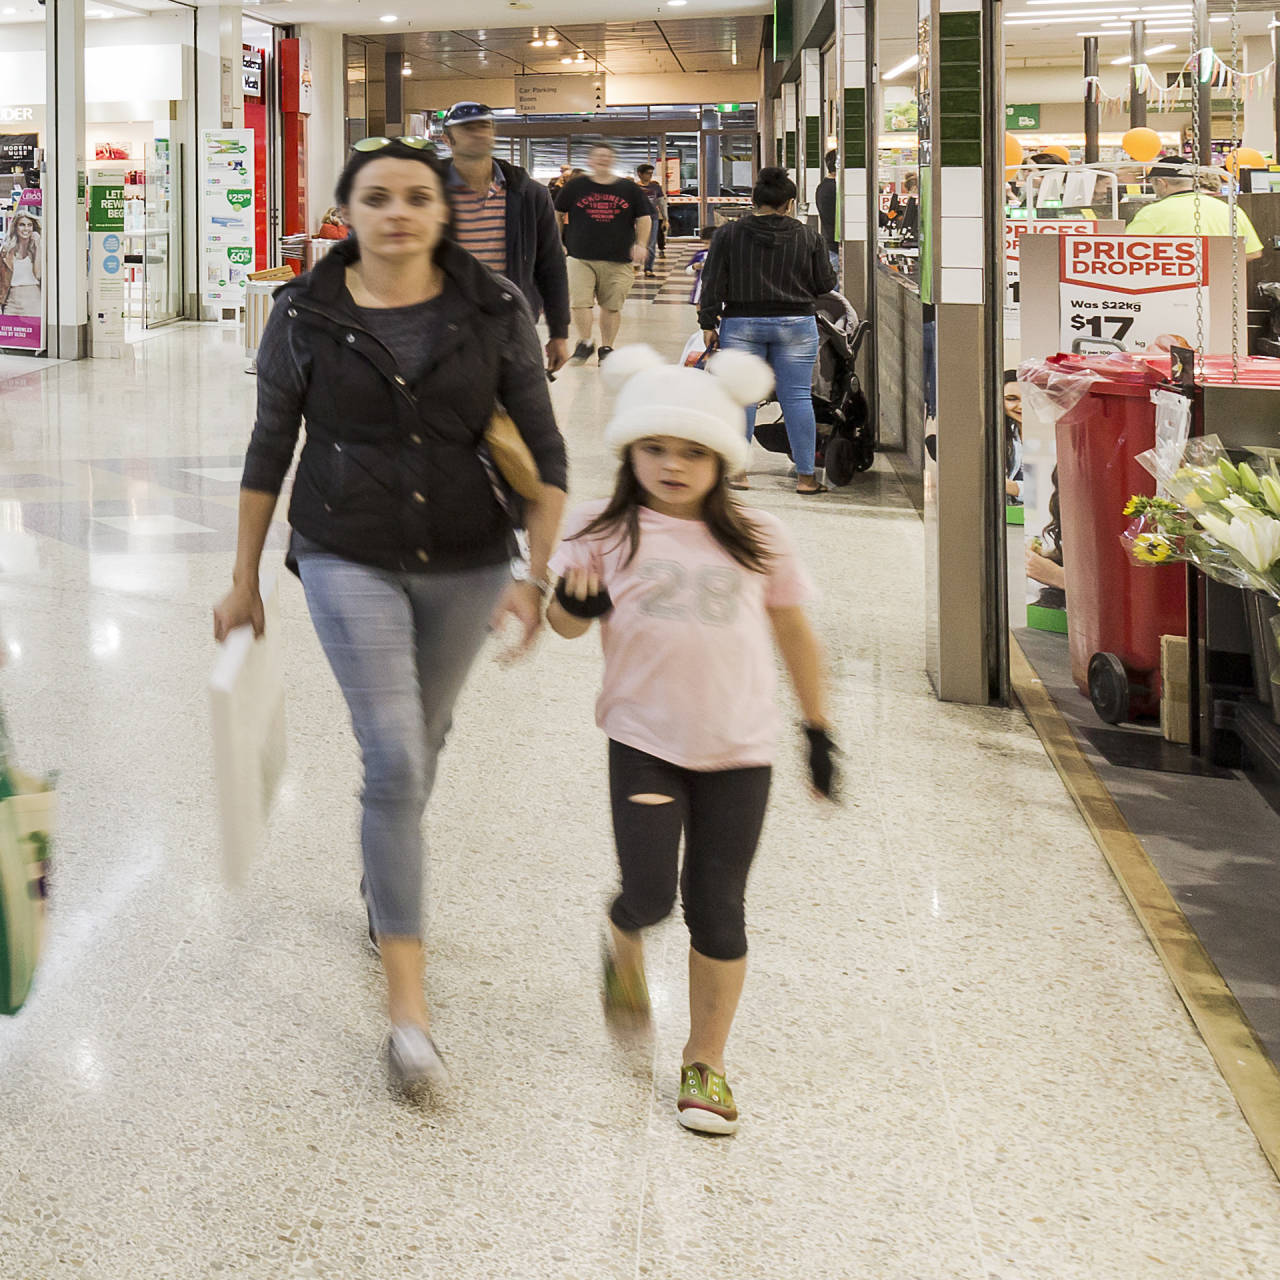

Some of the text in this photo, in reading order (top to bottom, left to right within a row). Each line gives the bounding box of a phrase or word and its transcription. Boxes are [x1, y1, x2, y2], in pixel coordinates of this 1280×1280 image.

[108, 209, 124, 218] BEG
[1072, 241, 1196, 261] PRICES
[1072, 260, 1196, 276] DROPPED
[1071, 300, 1141, 312] Was $22kg
[1070, 313, 1134, 342] $17
[1135, 340, 1146, 348] kg
